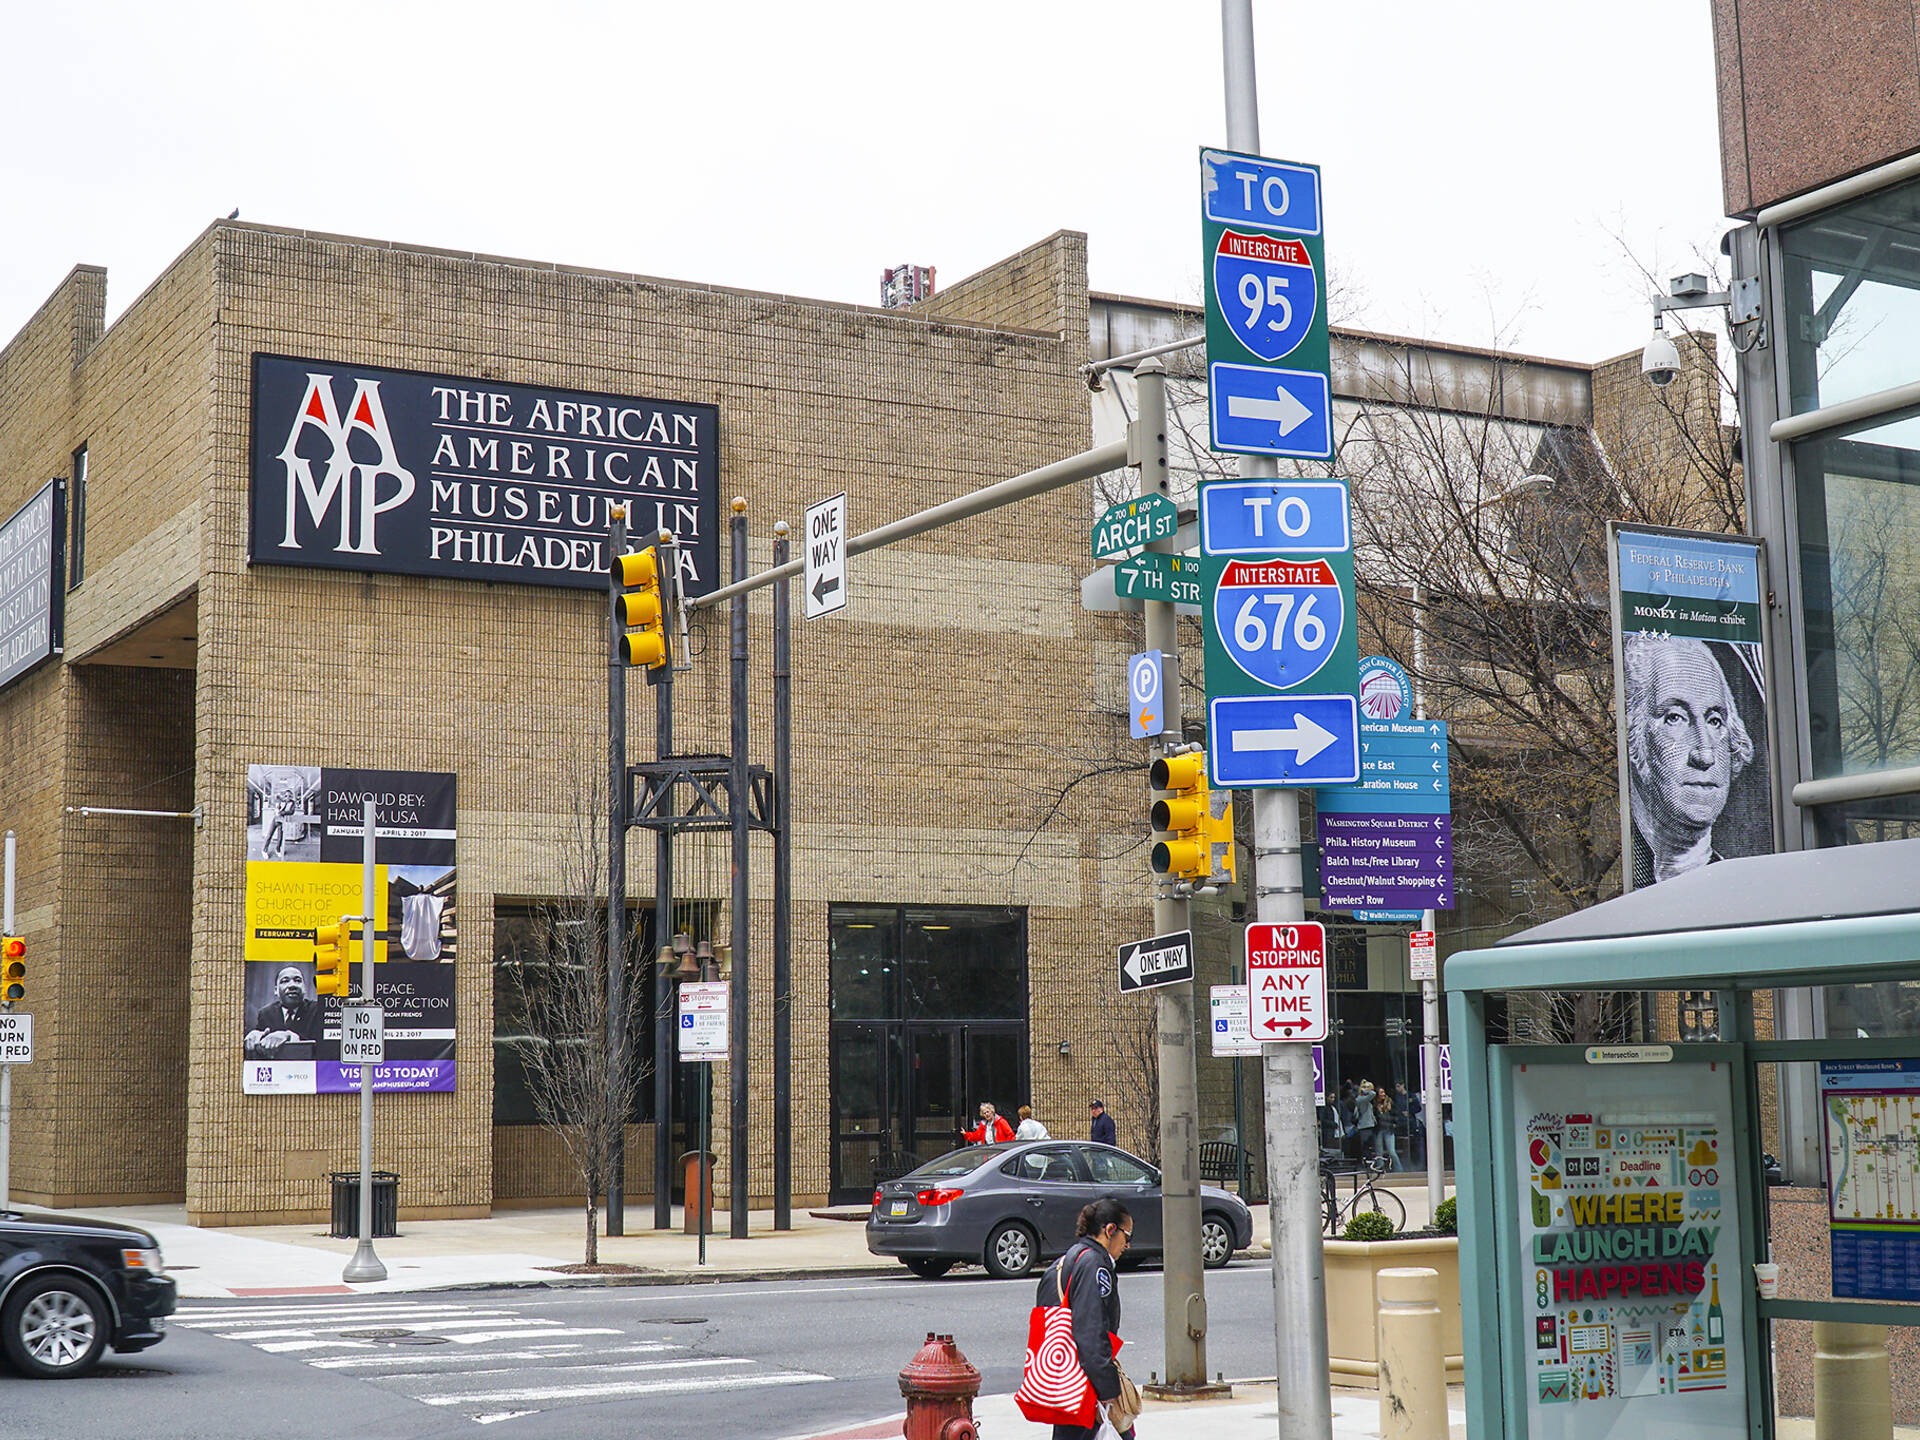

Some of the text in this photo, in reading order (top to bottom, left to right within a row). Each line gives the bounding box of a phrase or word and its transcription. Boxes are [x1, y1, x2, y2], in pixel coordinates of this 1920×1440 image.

[1235, 171, 1290, 216] TO
[1229, 237, 1298, 262] INTERSTATE
[1238, 273, 1292, 332] 95
[431, 386, 698, 447] THE AFRICAN
[430, 433, 698, 493] AMERICAN
[430, 479, 699, 537] MUSEUM IN
[1115, 501, 1151, 520] 700 W 600
[15, 495, 49, 549] AFRICAN
[813, 507, 838, 539] ONE
[1243, 497, 1311, 537] TO
[1096, 513, 1172, 554] ARCH ST
[429, 526, 701, 581] PHILADELA
[812, 537, 838, 569] WAY
[1171, 558, 1180, 572] N
[1185, 562, 1199, 572] 100
[1630, 549, 1745, 575] FEDERAL RESERVE BANK
[1235, 567, 1320, 584] INTERSTATE
[1665, 569, 1731, 588] PHILADELPHIA
[37, 576, 49, 608] IN
[1170, 581, 1200, 601] STR
[1234, 594, 1326, 651] 676
[1634, 606, 1746, 625] MONEY in Motion exhibit
[1141, 669, 1151, 693] P
[1391, 723, 1425, 733] Museum
[1362, 761, 1395, 770] ace East
[1394, 780, 1418, 790] House
[328, 790, 425, 807] DAWOUD BEY:
[328, 808, 419, 823] HARLM, USA
[1326, 837, 1416, 849] Phila. History Museum
[1327, 856, 1349, 866] Balch
[1391, 856, 1419, 868] Library
[256, 881, 304, 895] SHAWN
[1328, 875, 1436, 887] Chestnut/Walnut Shopping
[255, 897, 333, 911] CHURCH OF
[1328, 895, 1384, 906] Jewelers' Row
[256, 913, 306, 926] BROKEN
[1272, 927, 1299, 949] NO
[1140, 948, 1185, 973] ONE WAY
[1252, 950, 1321, 966] STOPPING
[376, 983, 415, 995] PEACE:
[1262, 974, 1310, 991] ANY
[384, 998, 401, 1008] OF
[403, 997, 449, 1008] ACTION
[1261, 996, 1312, 1012] TIME
[355, 1013, 370, 1024] NO
[0, 1033, 24, 1041] URN
[349, 1028, 377, 1040] TURN
[6, 1046, 30, 1055] RED
[344, 1044, 381, 1055] ON RED
[1602, 1051, 1639, 1059] Intersection
[340, 1067, 439, 1078] VIS US TODAY!
[1568, 1160, 1598, 1172] 01 04
[1620, 1160, 1661, 1172] Deadline
[1569, 1192, 1685, 1226] WHERE
[1534, 1226, 1720, 1264] LAUNCH DAY
[1553, 1261, 1706, 1301] HAPPENS
[1669, 1328, 1686, 1337] ETA
